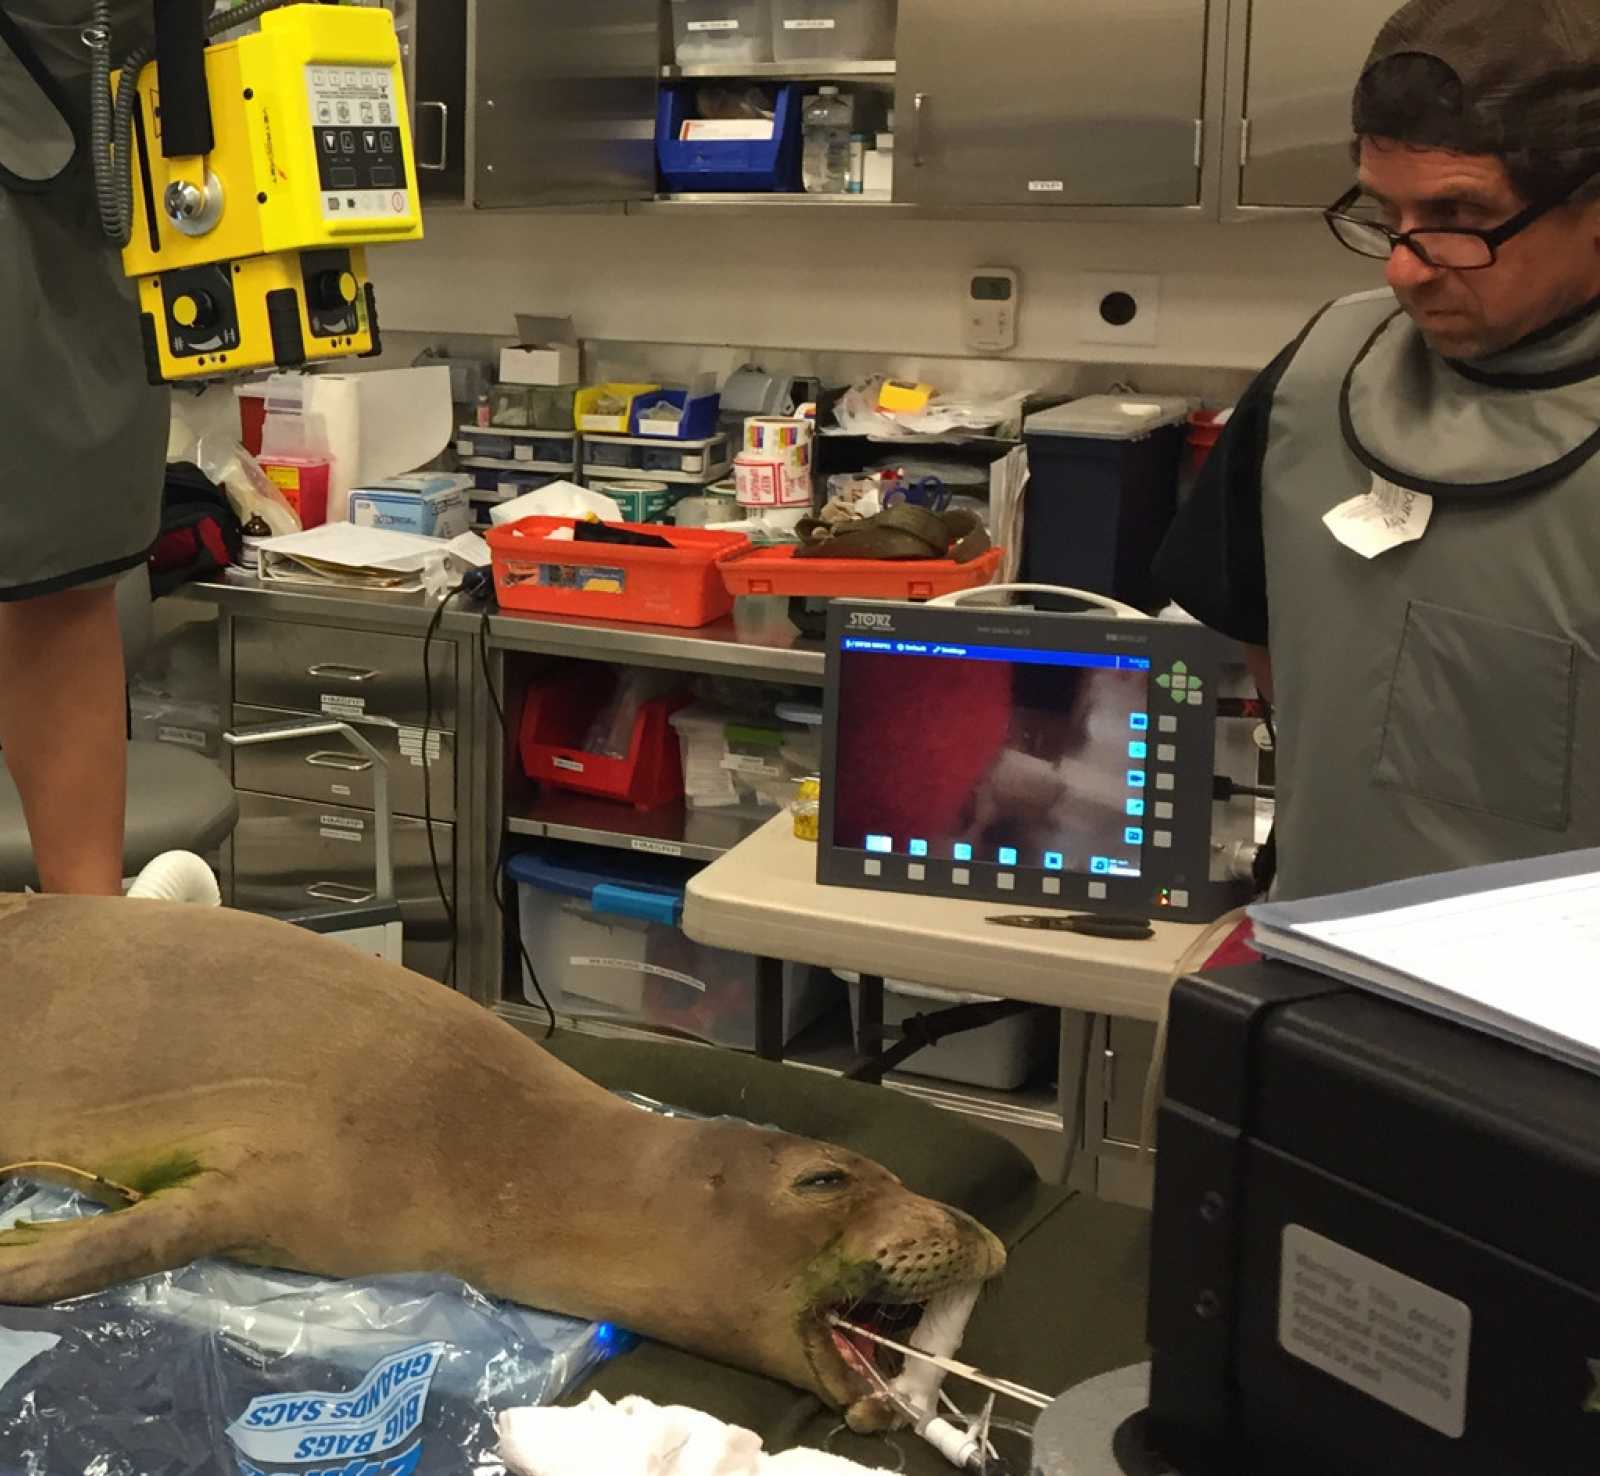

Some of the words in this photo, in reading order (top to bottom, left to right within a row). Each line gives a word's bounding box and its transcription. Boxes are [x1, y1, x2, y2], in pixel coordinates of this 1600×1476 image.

[850, 612, 891, 626] STORZ
[331, 1352, 432, 1419] GRANDS
[246, 1400, 325, 1426] SACS
[382, 1394, 422, 1446] BIG
[294, 1430, 377, 1459] BAGS
